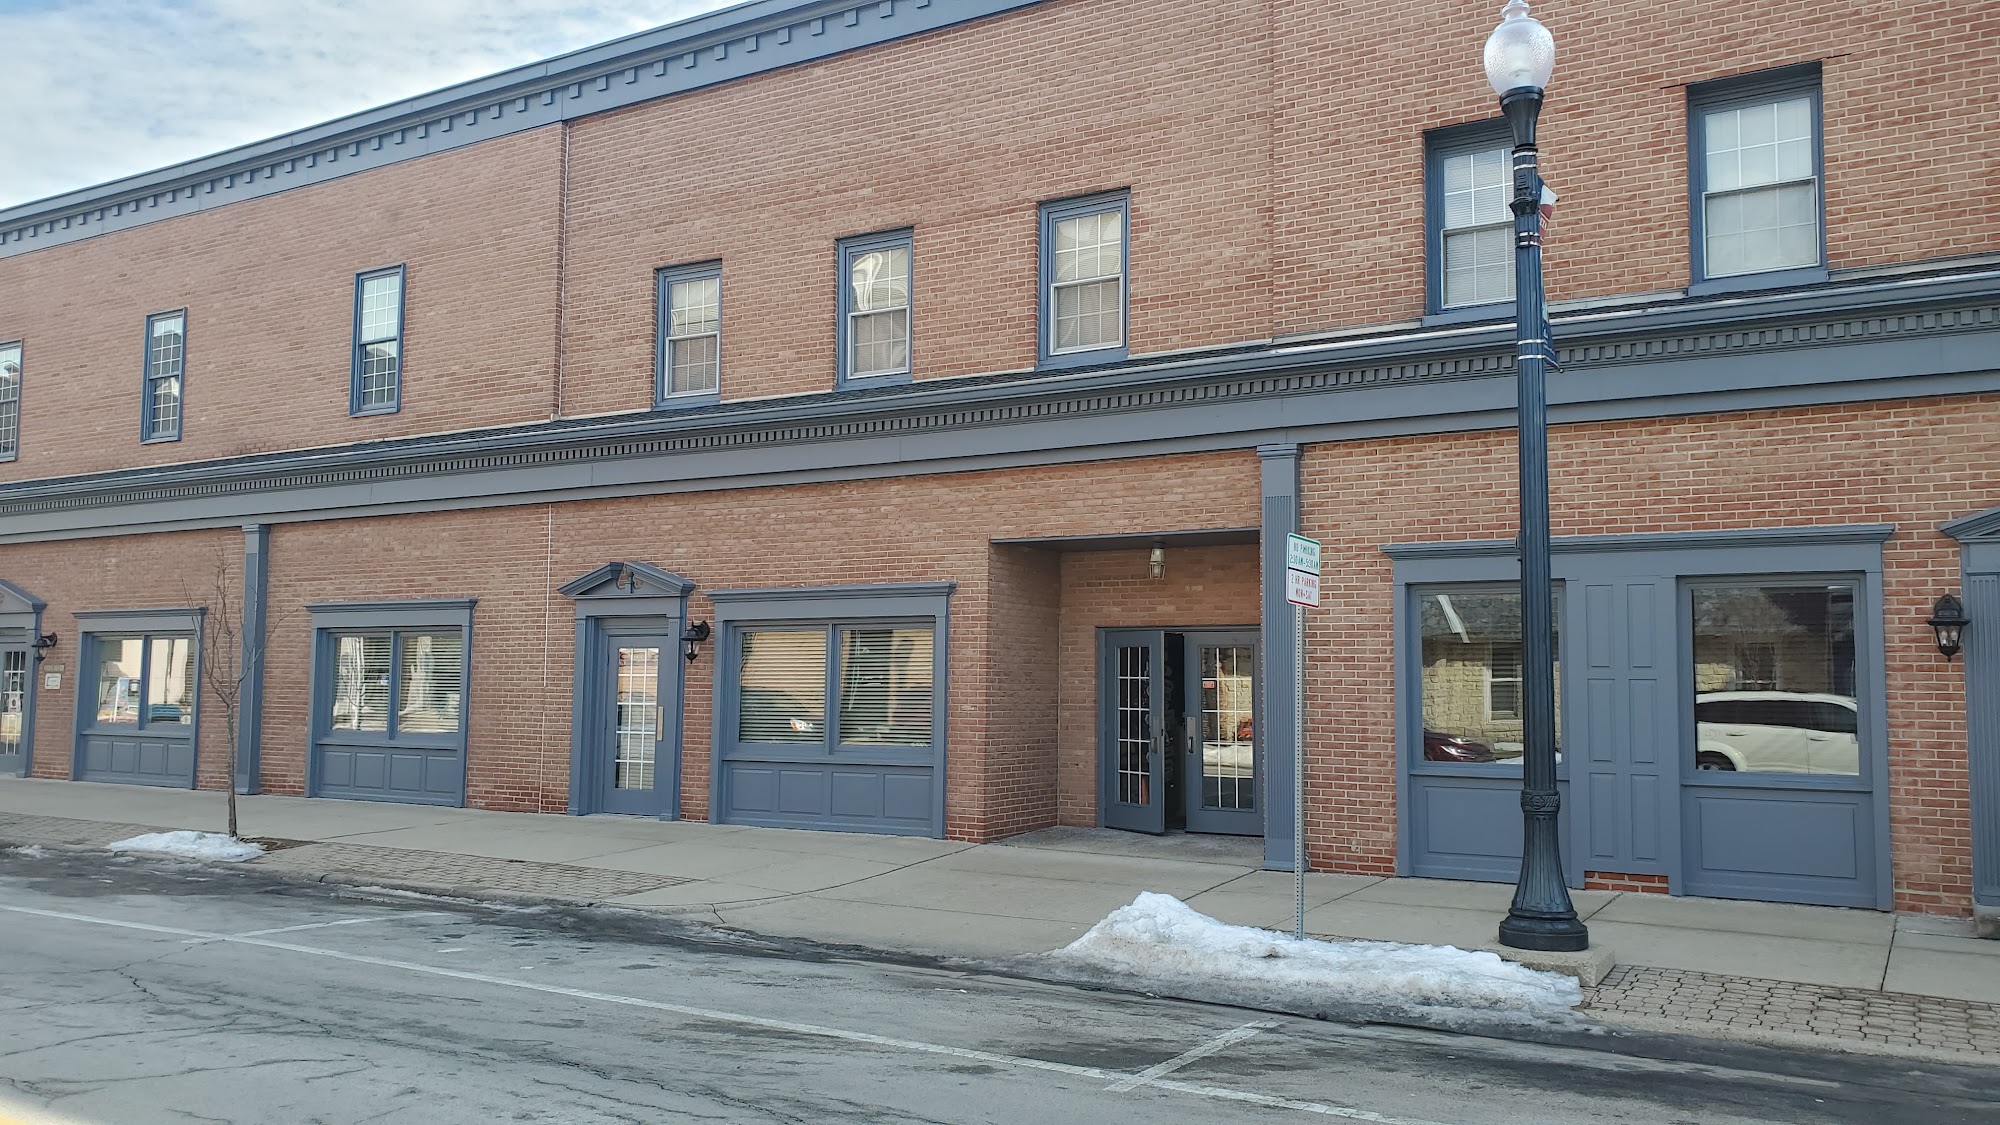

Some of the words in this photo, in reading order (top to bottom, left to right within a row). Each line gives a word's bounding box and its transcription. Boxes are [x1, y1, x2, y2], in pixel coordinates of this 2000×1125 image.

[1294, 542, 1299, 552] NO
[1300, 544, 1316, 557] PARKING
[1295, 575, 1300, 586] HR
[1302, 576, 1317, 589] PARKING
